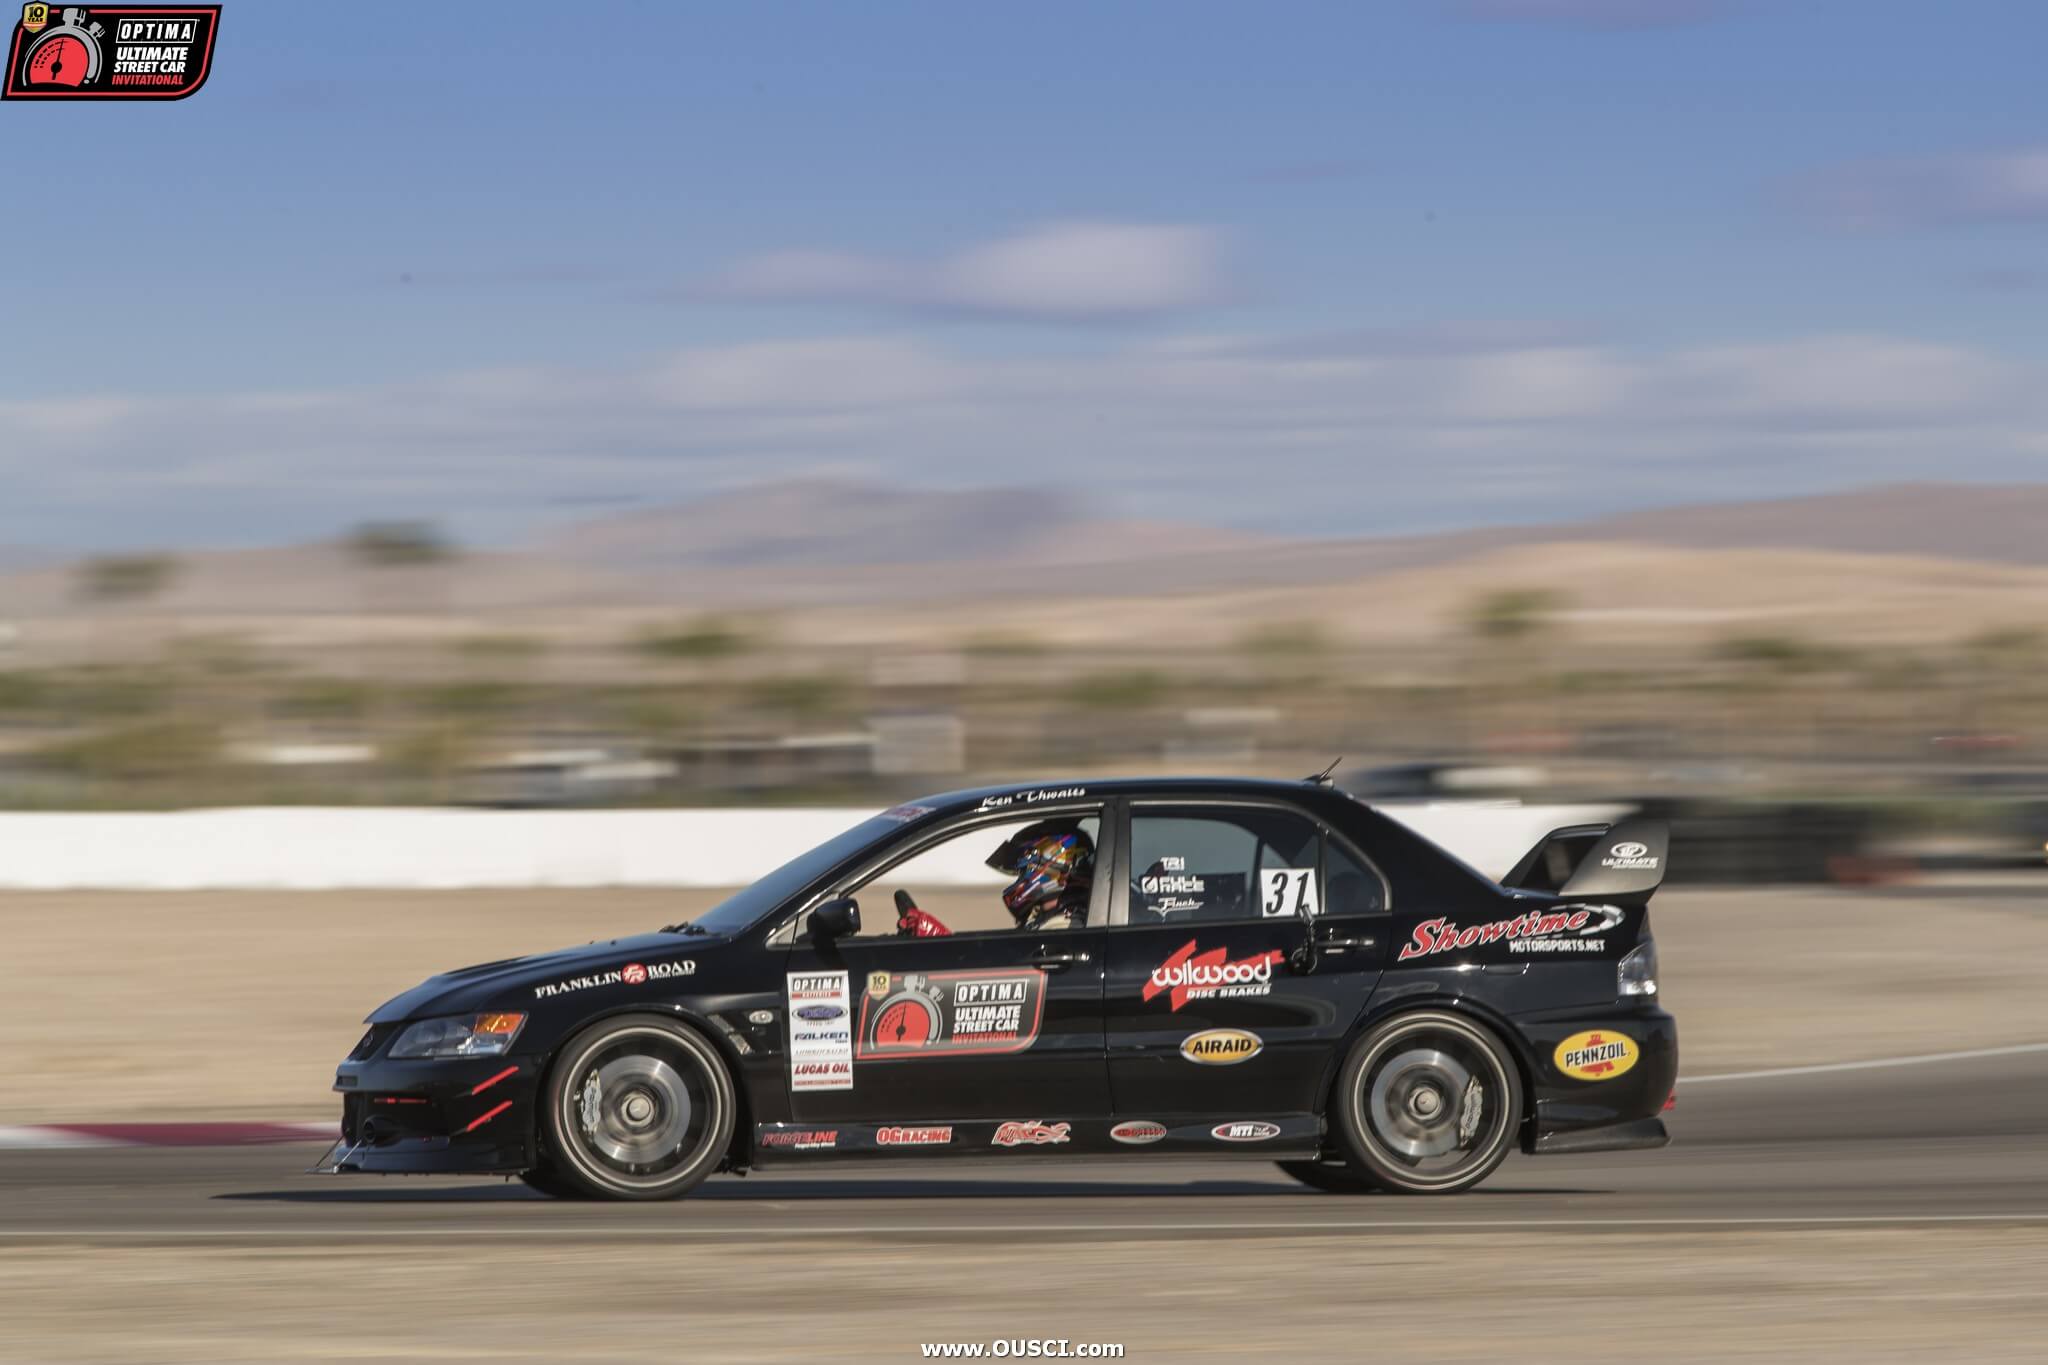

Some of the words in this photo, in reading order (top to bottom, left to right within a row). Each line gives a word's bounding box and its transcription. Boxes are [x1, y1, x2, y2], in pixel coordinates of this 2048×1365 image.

[1601, 857, 1659, 867] ULTIMATE
[1266, 872, 1309, 915] 31
[1398, 909, 1591, 962] Showtime
[1509, 939, 1605, 953] MOTORSPORTS.NET
[1151, 956, 1272, 987] wilwood
[534, 970, 622, 999] FRANKLIN
[647, 959, 696, 976] ROAD
[793, 977, 842, 991] OPTIMA
[872, 975, 887, 986] 10
[957, 985, 1023, 1002] OPTIMA
[1187, 988, 1216, 999] DISC
[1219, 986, 1271, 998] BRAKES
[954, 1006, 1020, 1021] ULTIMATE
[952, 1022, 995, 1034] STREET
[996, 1020, 1019, 1031] CAR
[794, 1031, 849, 1041] FALKEN
[1192, 1039, 1252, 1054] AIRAID
[1565, 1042, 1626, 1067] PENNZOIL
[794, 1064, 830, 1075] LUCAS
[832, 1063, 850, 1074] OIL
[1230, 1124, 1254, 1136] MTI
